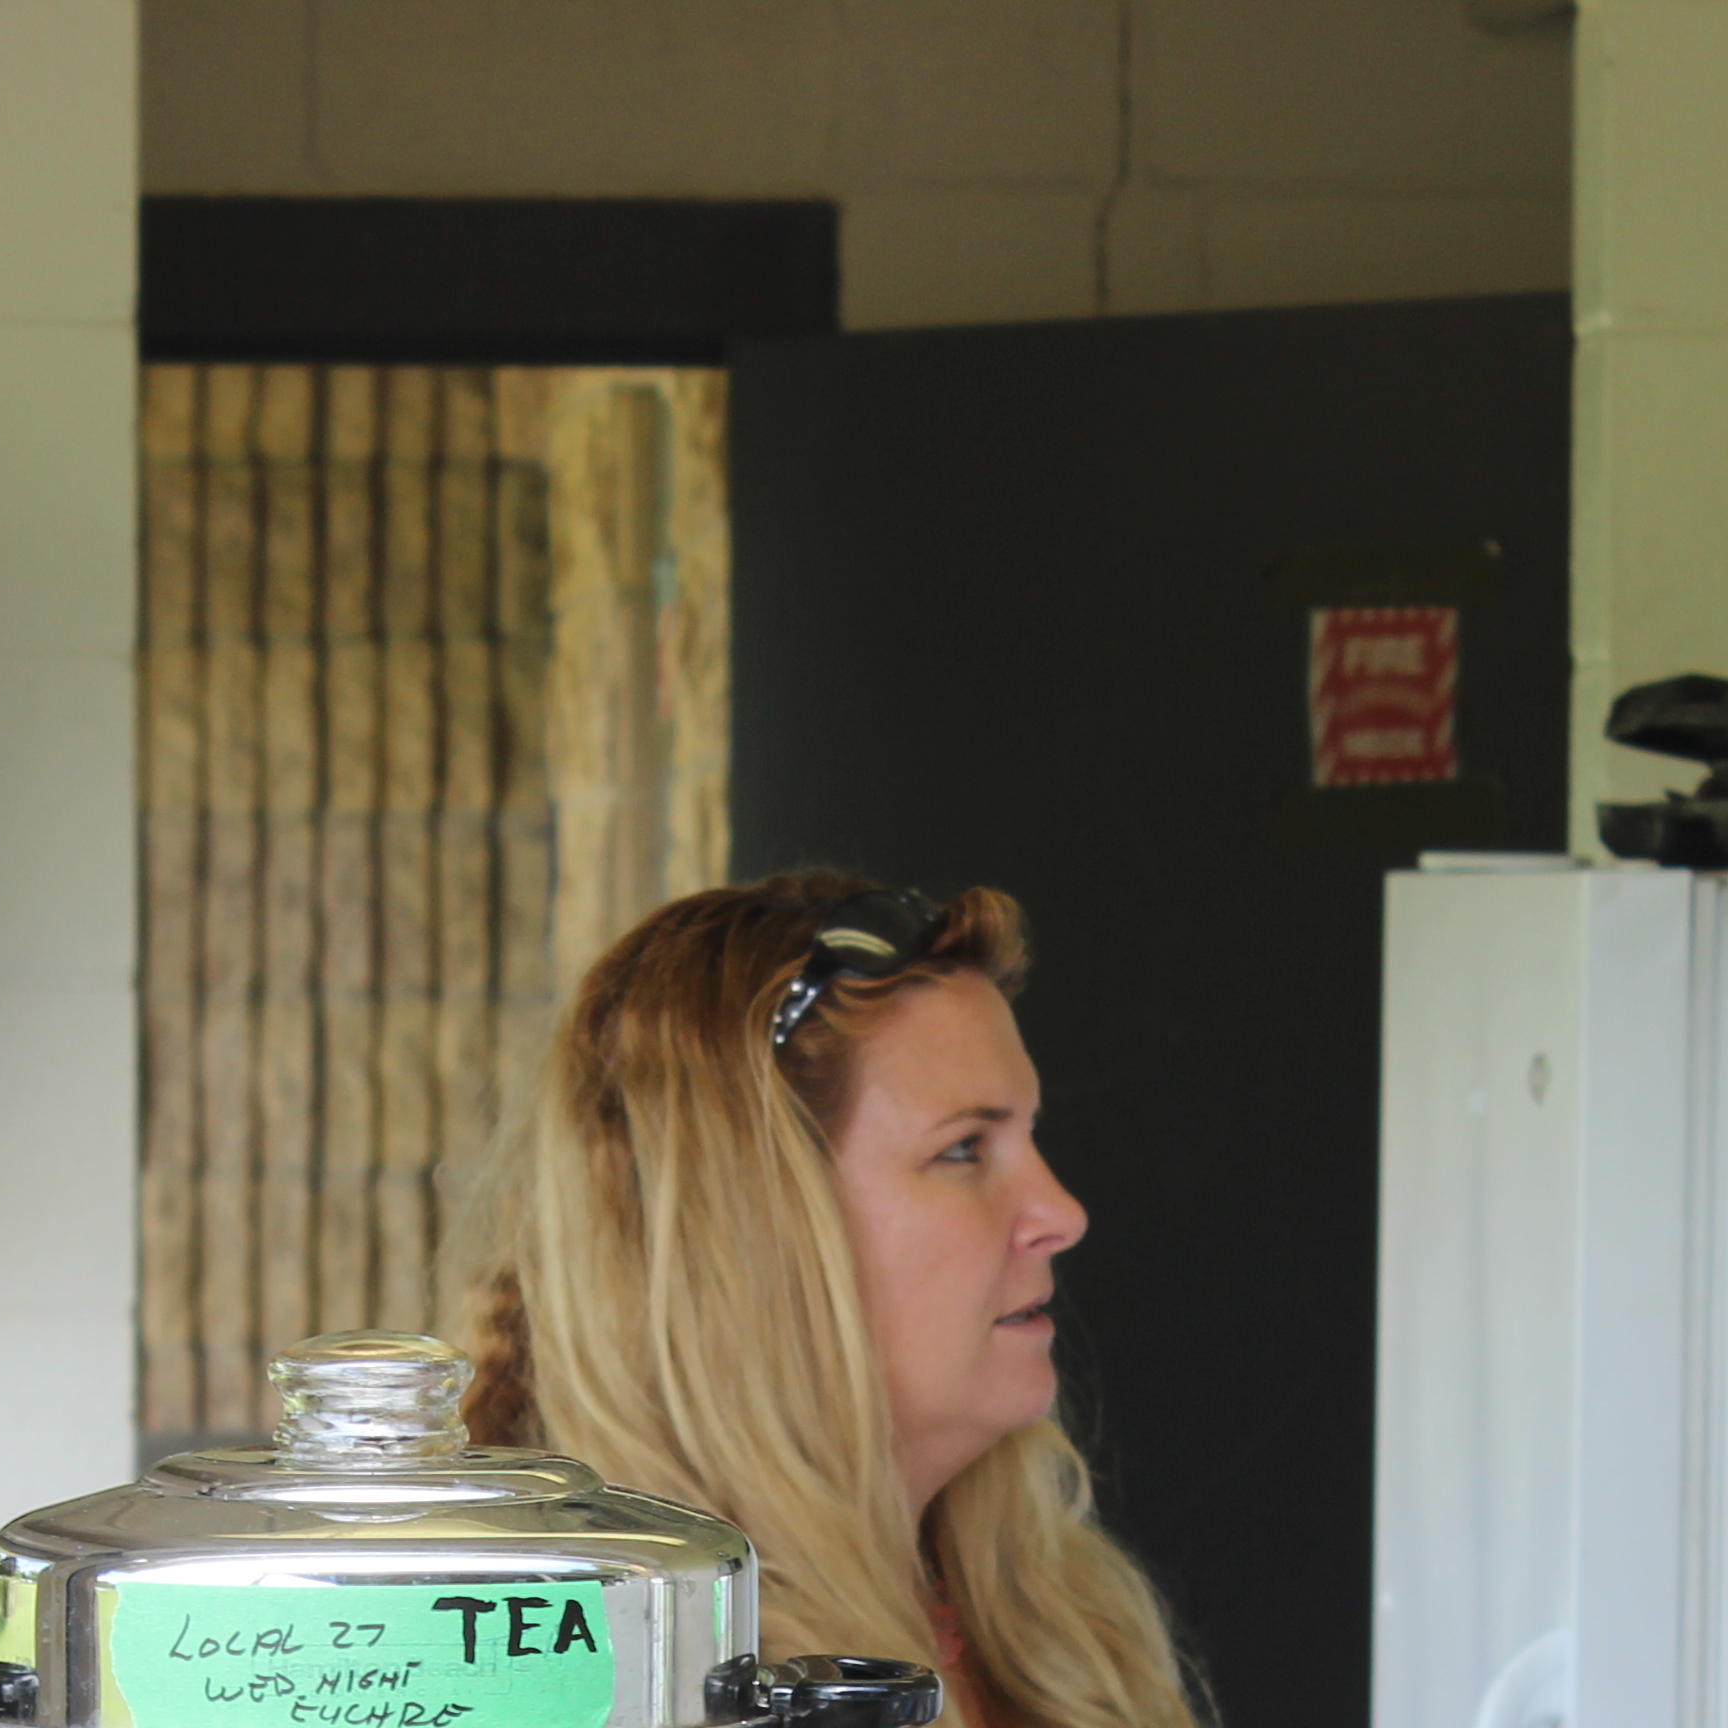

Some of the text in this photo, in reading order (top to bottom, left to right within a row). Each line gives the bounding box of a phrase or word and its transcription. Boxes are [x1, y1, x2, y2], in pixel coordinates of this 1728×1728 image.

[170, 1614, 386, 1661] LOCAL 27
[431, 1595, 598, 1664] TEA
[316, 1661, 422, 1696] NIGHT
[290, 1696, 475, 1728] EUCHRE
